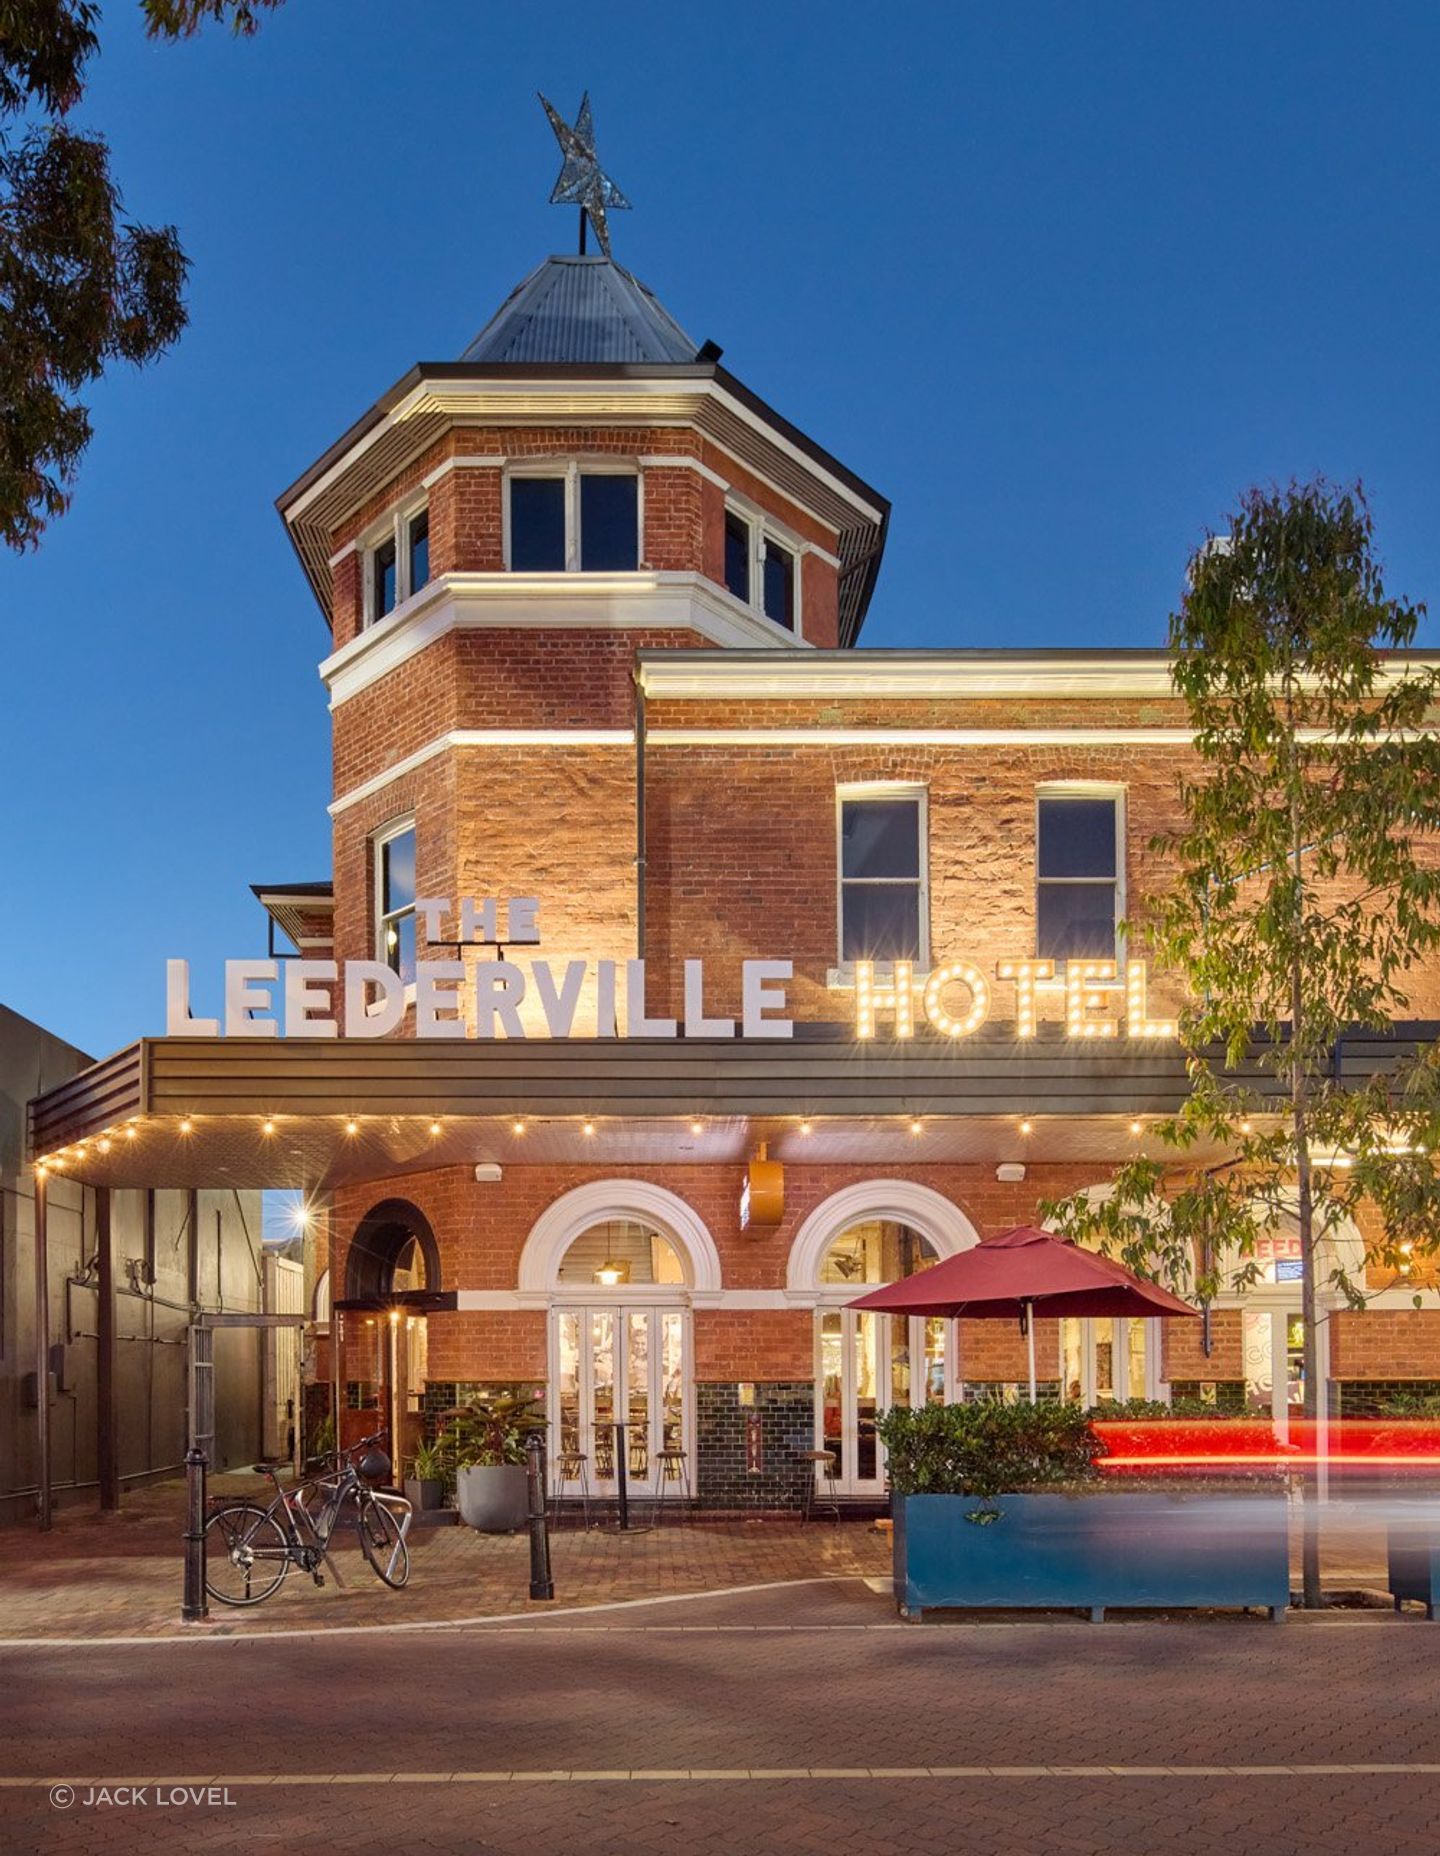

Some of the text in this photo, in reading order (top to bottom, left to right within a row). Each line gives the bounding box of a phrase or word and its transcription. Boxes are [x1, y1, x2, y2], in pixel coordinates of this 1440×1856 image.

[415, 896, 540, 942] THE
[166, 958, 1179, 1038] LEEDERVILLE HOTEL
